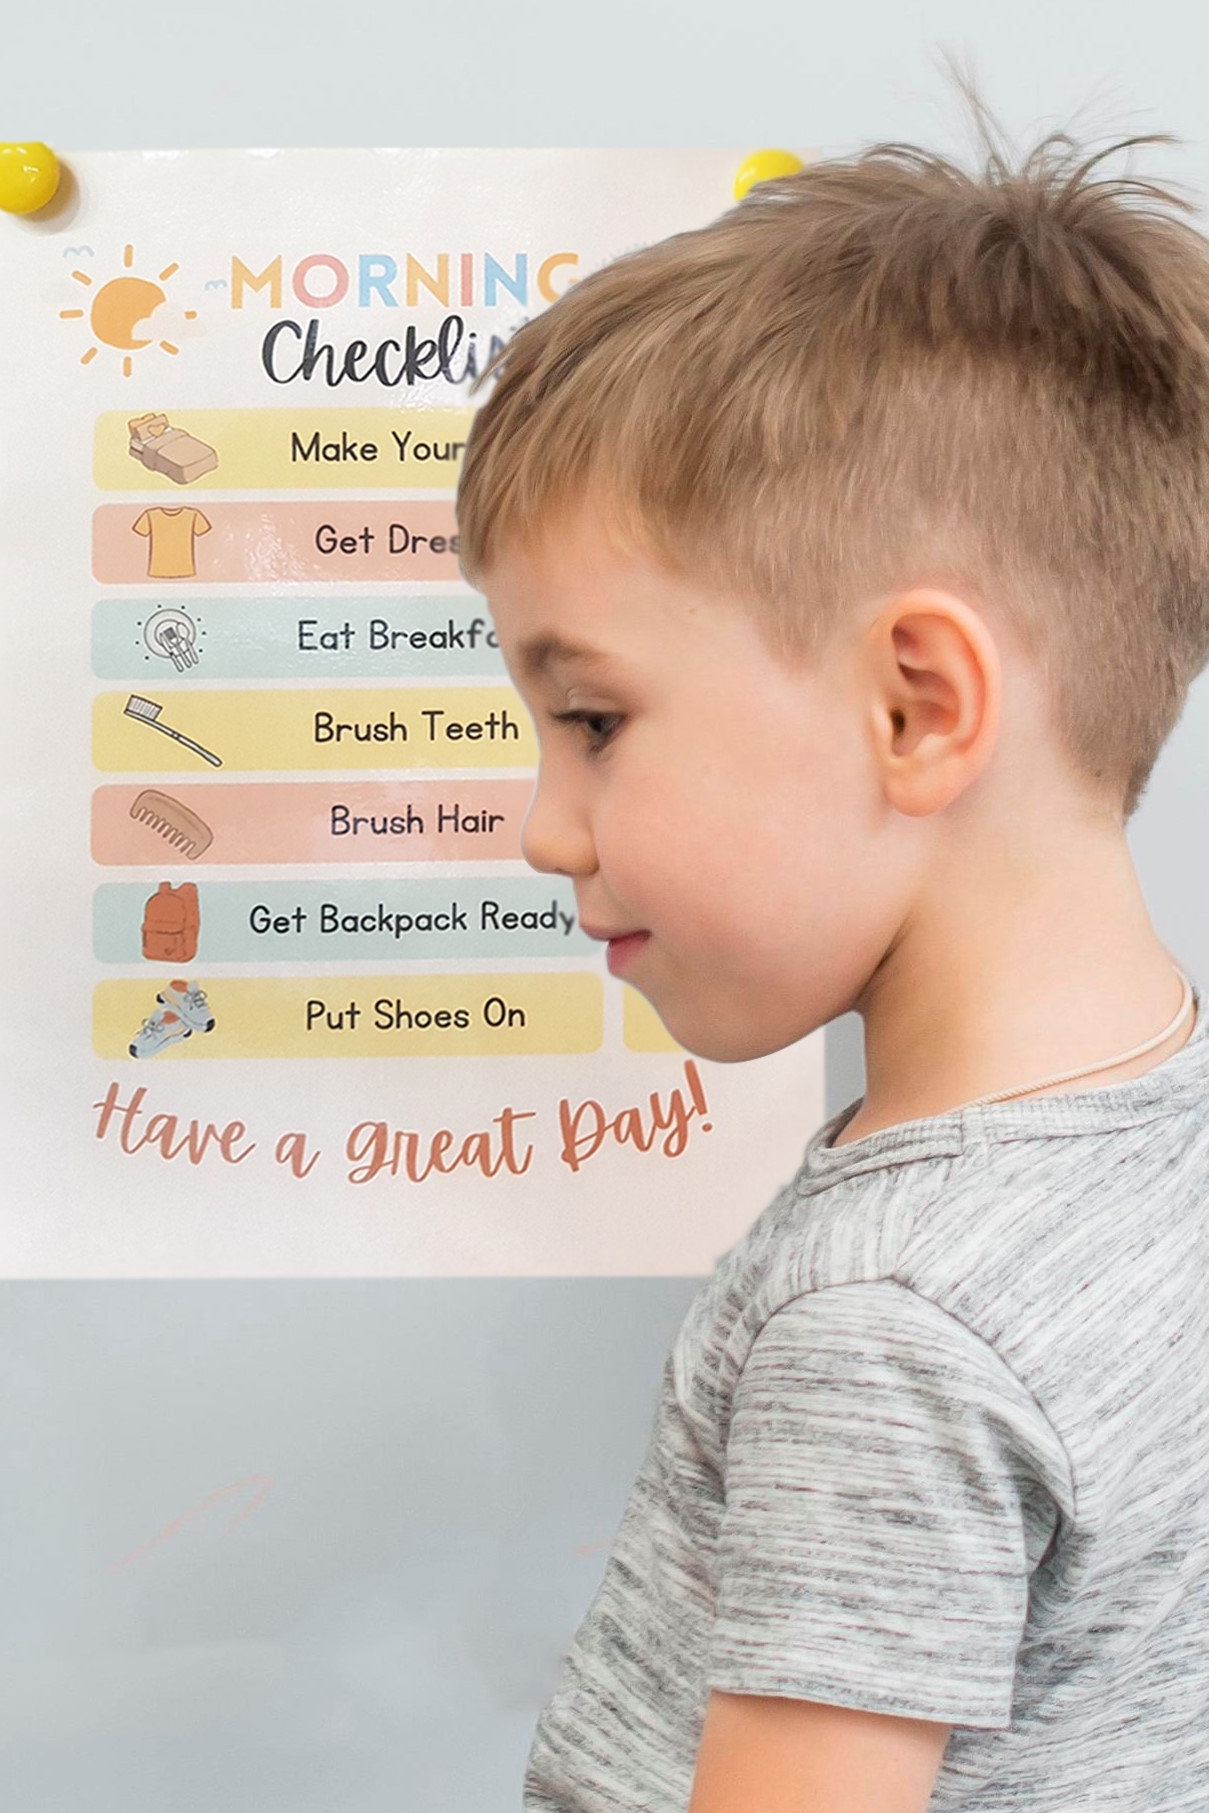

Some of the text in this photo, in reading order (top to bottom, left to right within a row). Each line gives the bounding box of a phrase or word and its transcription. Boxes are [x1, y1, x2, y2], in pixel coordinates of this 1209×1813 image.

[291, 431, 466, 463] Make Your
[316, 524, 375, 555] Get
[298, 619, 356, 651] Eat
[315, 710, 520, 743] Brush Teeth
[329, 805, 505, 837] Brush Hair
[249, 900, 575, 939] Get Backpack Ready
[307, 997, 526, 1030] Put Shoes On
[93, 1060, 712, 1184] Have a great Day!
